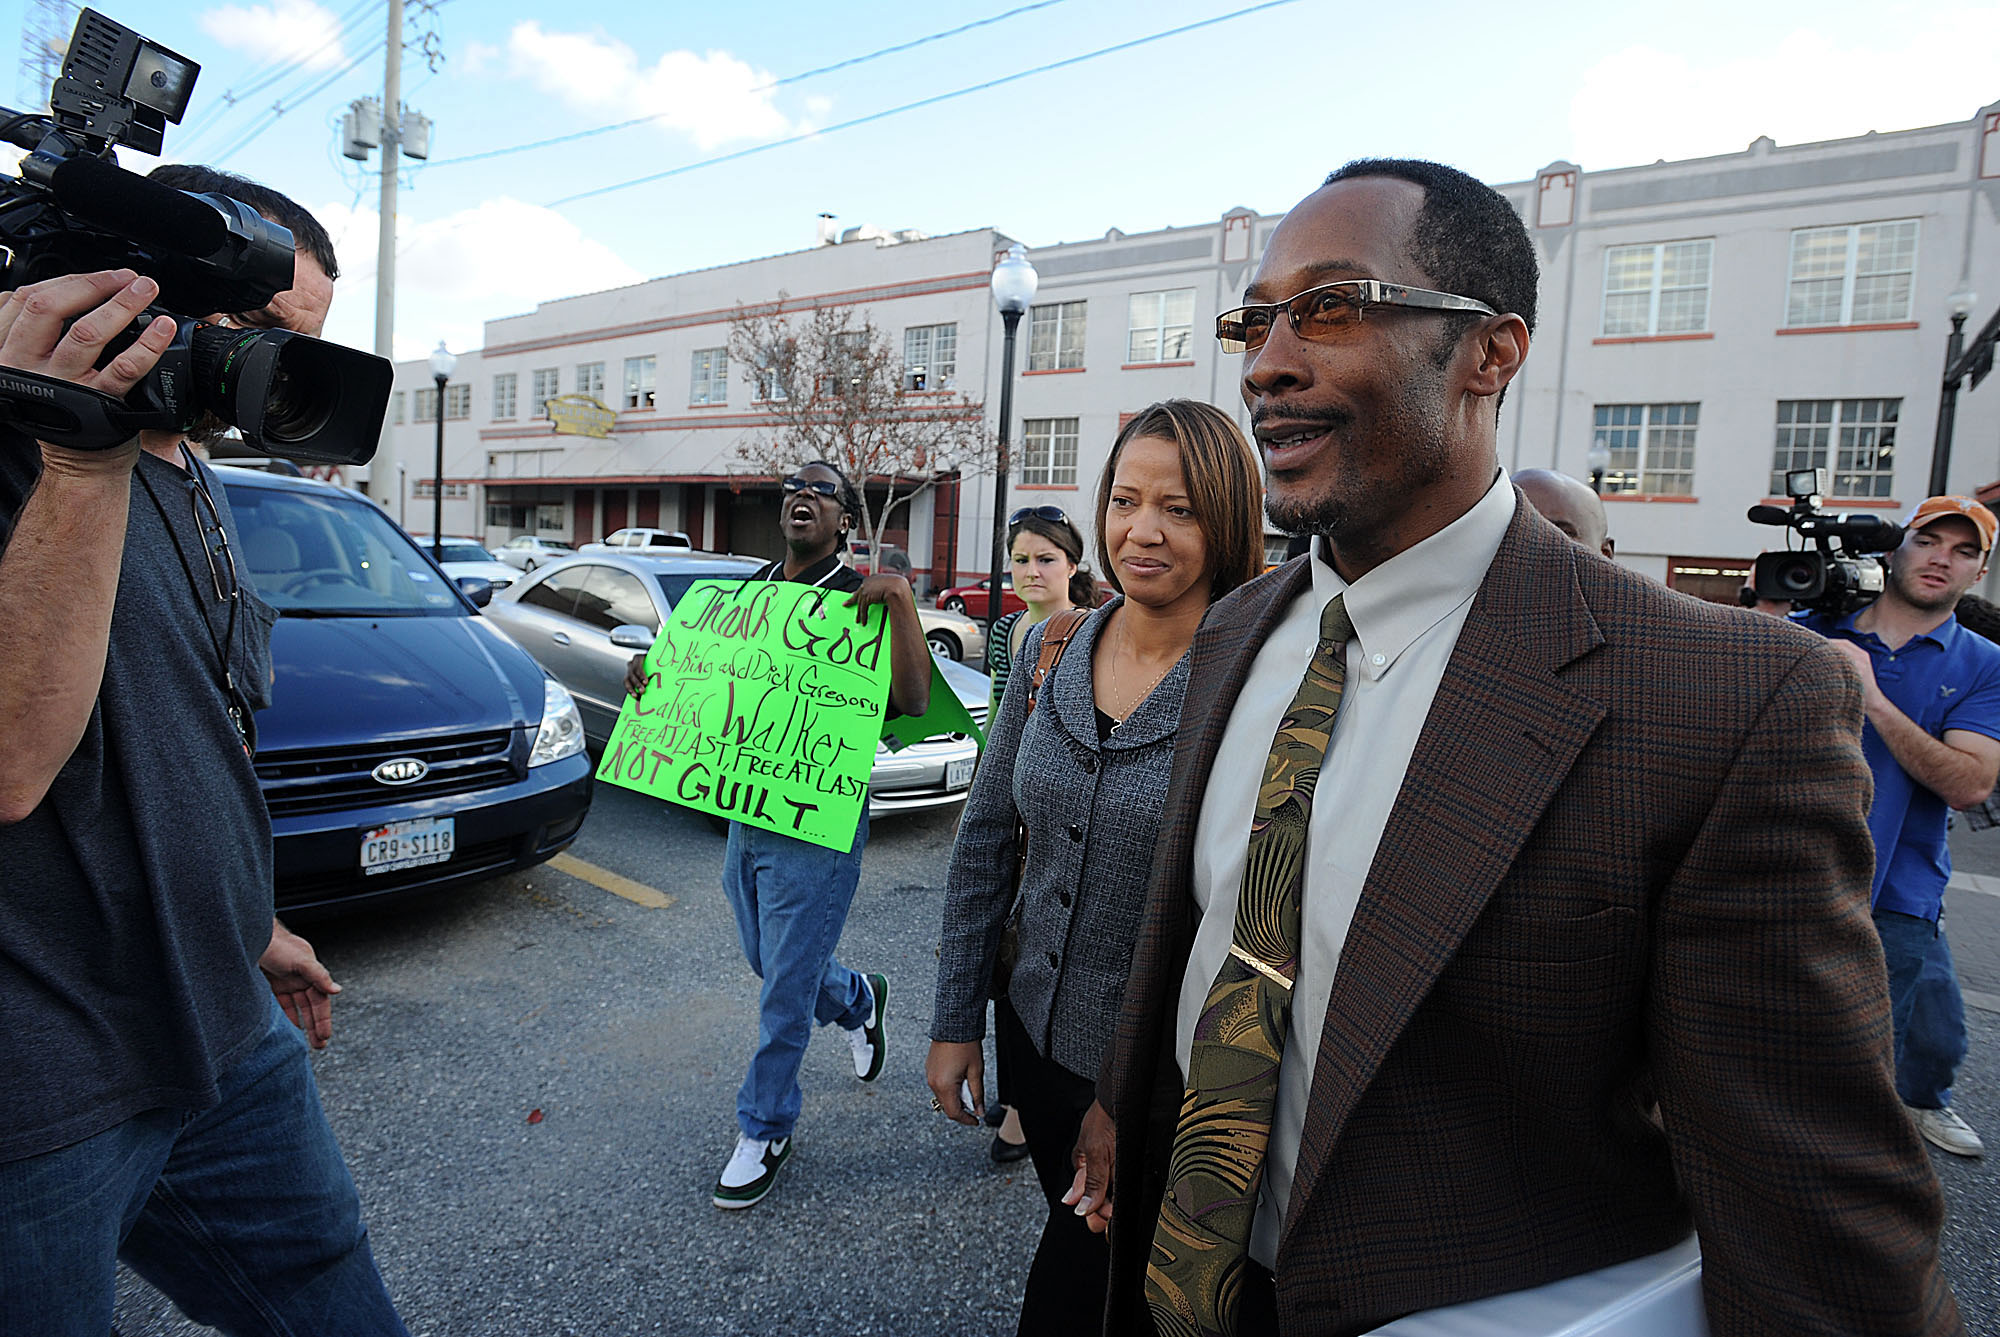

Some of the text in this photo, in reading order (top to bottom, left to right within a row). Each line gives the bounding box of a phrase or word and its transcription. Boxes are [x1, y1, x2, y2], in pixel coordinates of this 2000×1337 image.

[681, 583, 889, 672] Thank God
[675, 641, 720, 685] King
[751, 648, 794, 692] Dick
[799, 664, 879, 717] Gregory
[721, 680, 858, 768] Walker
[382, 761, 420, 780] KIA
[601, 741, 674, 785] NOT
[732, 746, 786, 780] FREE
[785, 759, 818, 784] AT
[816, 767, 872, 803] LAST
